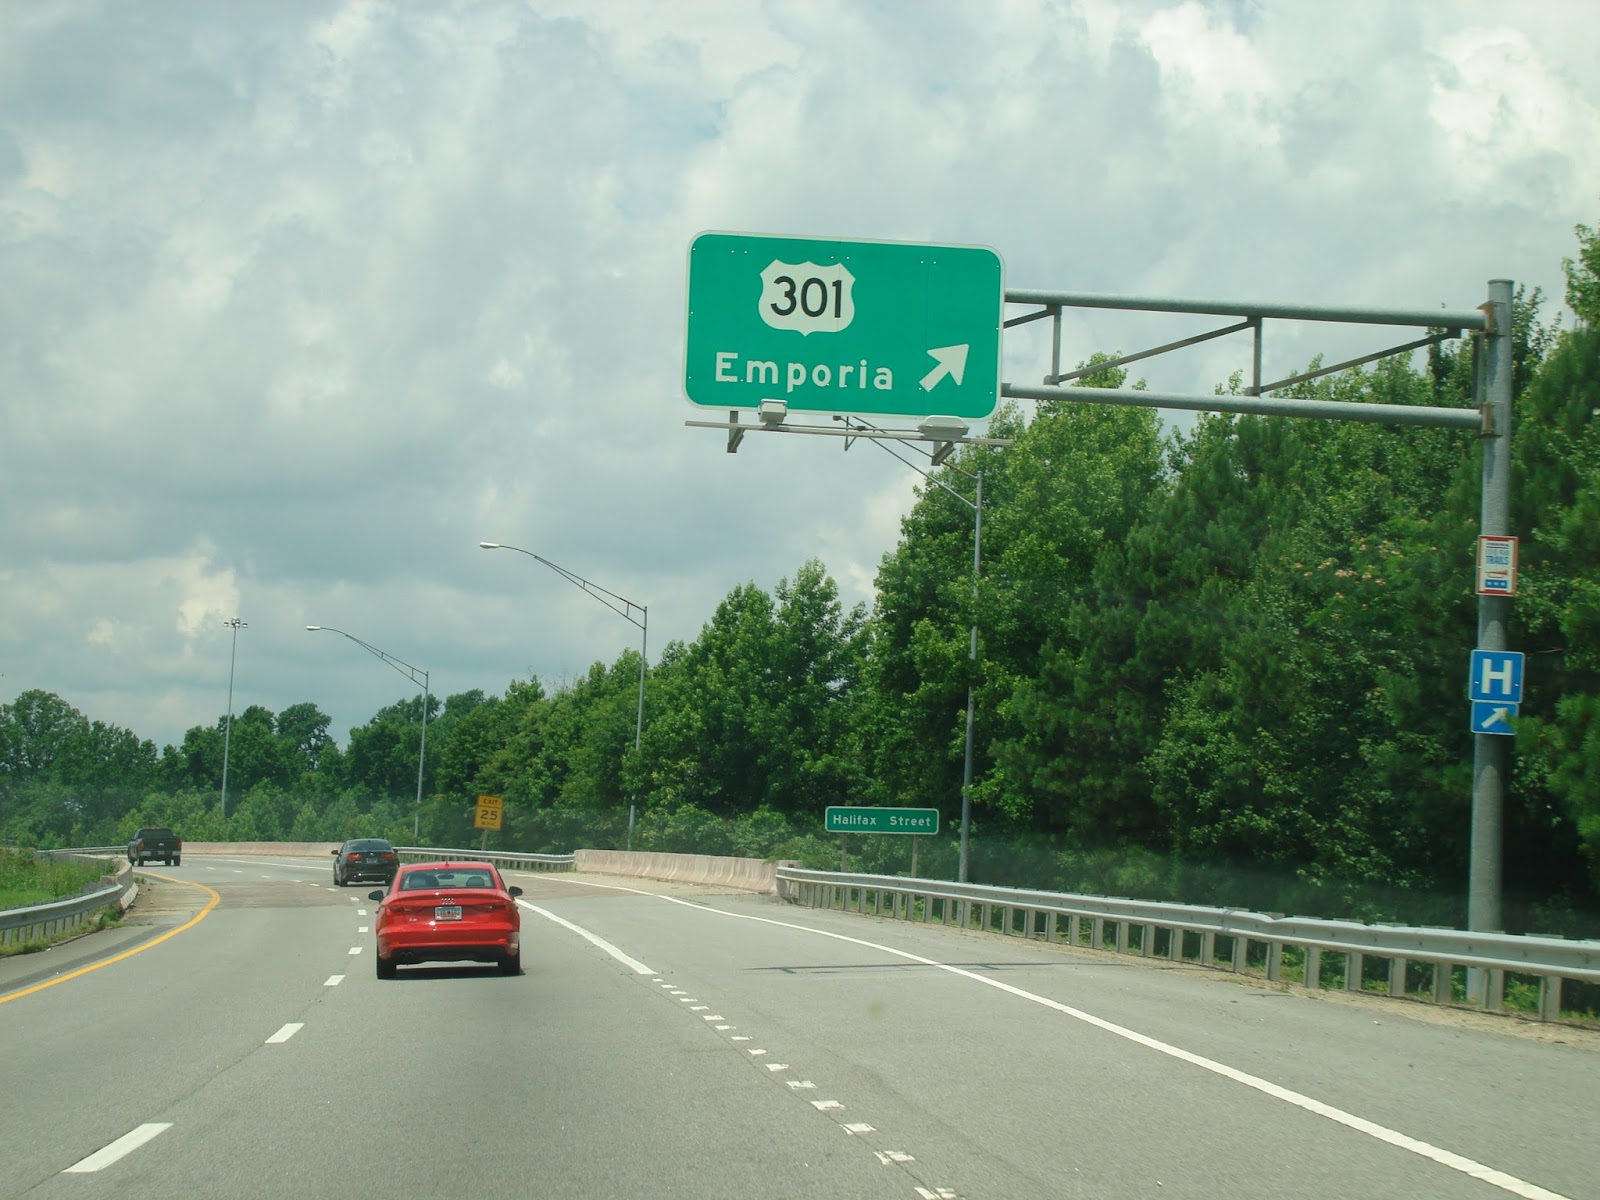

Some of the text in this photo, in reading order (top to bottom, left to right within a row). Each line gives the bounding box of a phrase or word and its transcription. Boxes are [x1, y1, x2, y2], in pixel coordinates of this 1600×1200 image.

[770, 275, 843, 319] 301
[715, 351, 893, 393] Emporia
[1481, 658, 1513, 695] H
[480, 809, 498, 820] 25
[833, 814, 932, 827] Halifax Street
